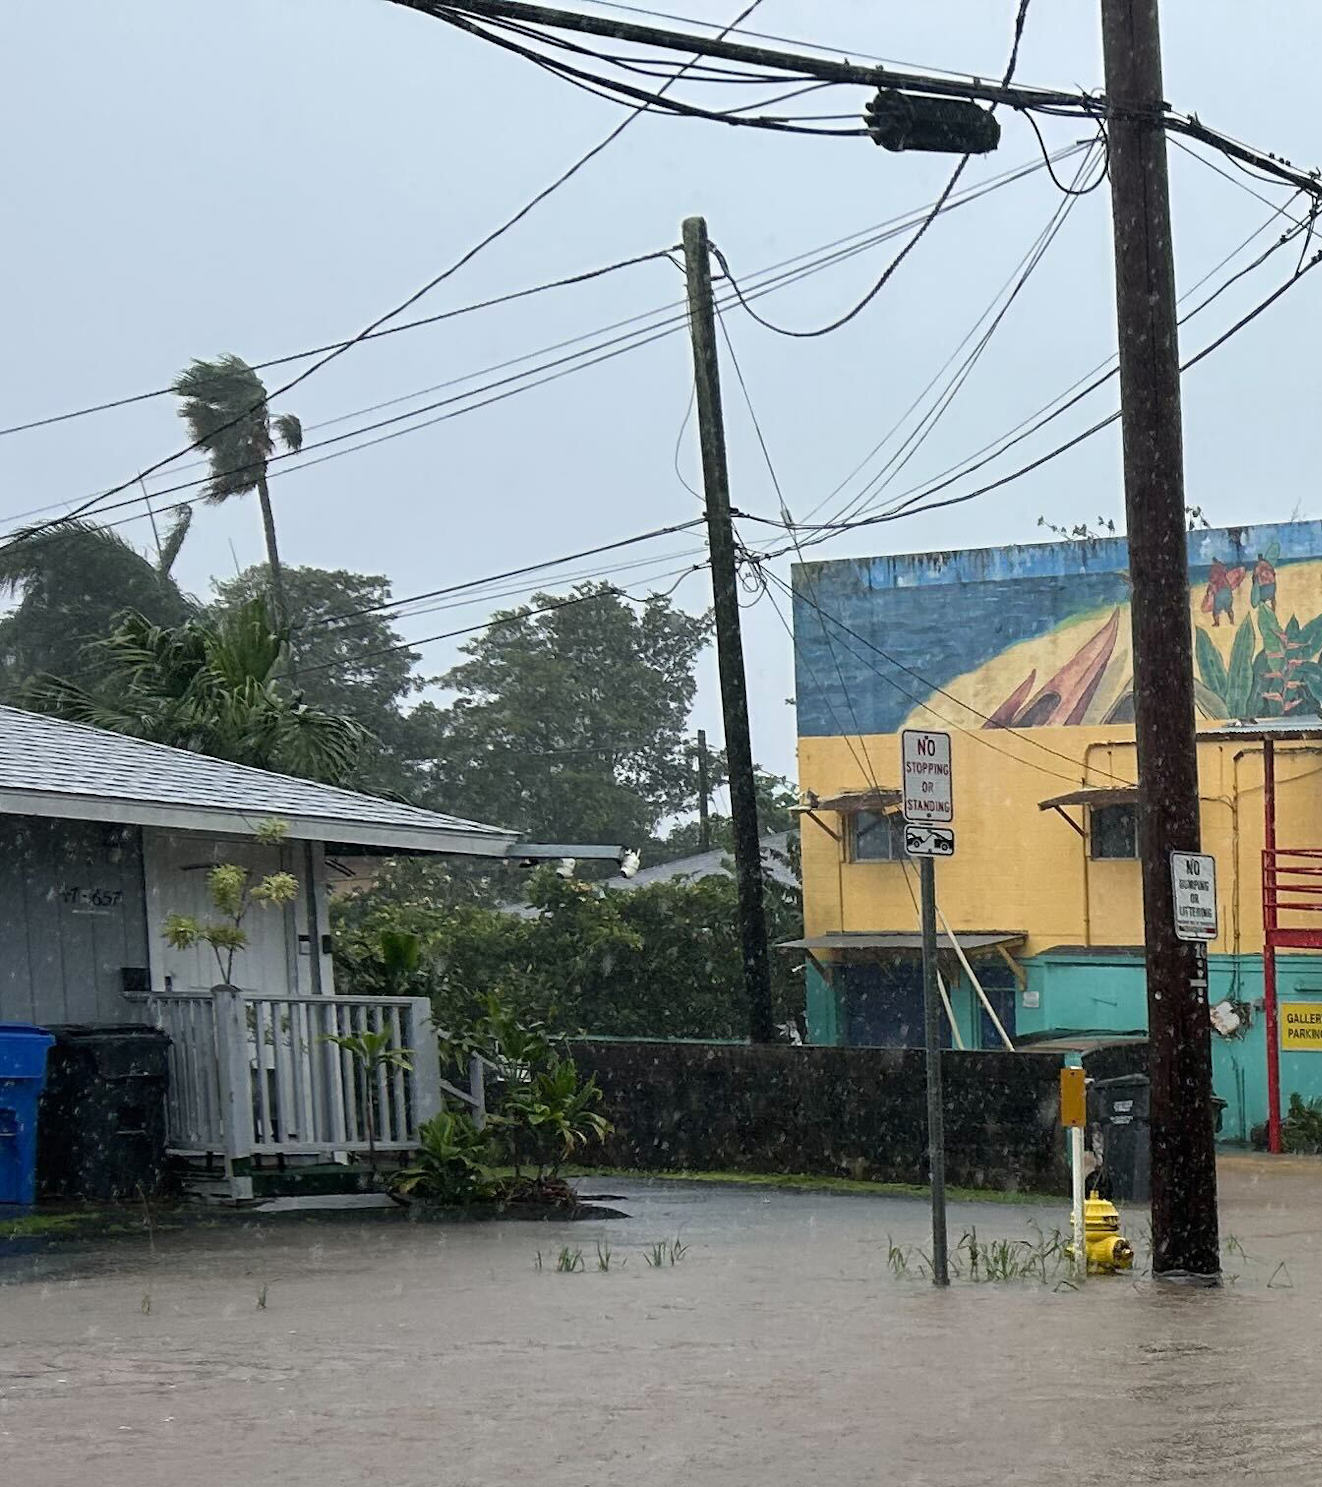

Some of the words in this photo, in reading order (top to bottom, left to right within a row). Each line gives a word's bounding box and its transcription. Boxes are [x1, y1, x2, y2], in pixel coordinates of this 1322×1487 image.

[917, 739, 935, 756] NO
[906, 761, 949, 775] STOPPING
[922, 781, 934, 793] OR
[907, 800, 950, 812] STANDING
[1186, 860, 1200, 875] NO
[1190, 893, 1199, 903] OR
